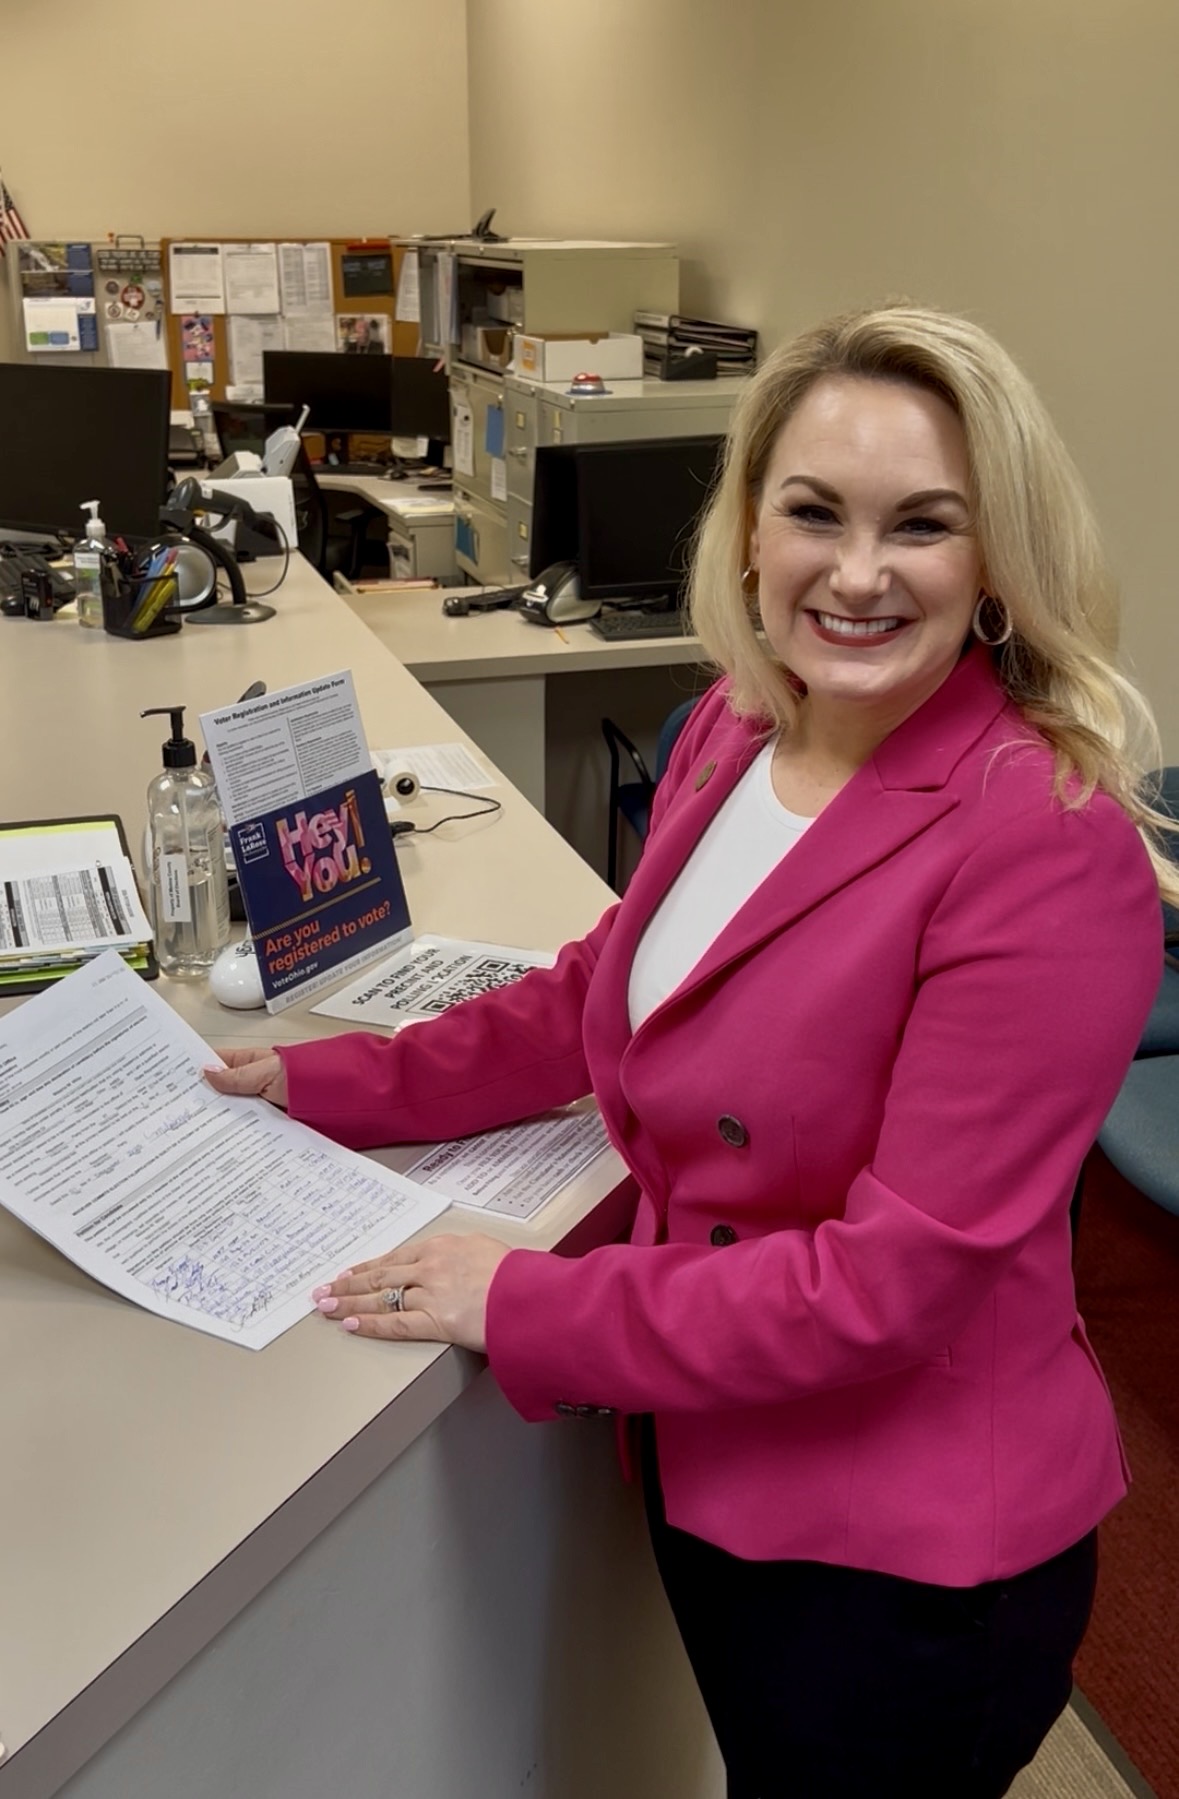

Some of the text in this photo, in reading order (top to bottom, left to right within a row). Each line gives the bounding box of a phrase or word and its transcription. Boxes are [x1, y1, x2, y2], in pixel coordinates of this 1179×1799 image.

[214, 715, 231, 725] Voter
[232, 704, 268, 719] Registration
[281, 690, 311, 704] Information
[312, 683, 330, 694] Update
[331, 679, 344, 687] Form
[240, 832, 262, 845] Frank
[241, 840, 266, 853] LaRose
[267, 934, 293, 956] Are
[293, 920, 321, 946] you
[268, 926, 340, 974] registered
[343, 923, 357, 936] to
[358, 901, 390, 928] vote?
[272, 962, 318, 989] VoteOhio.gov
[320, 968, 343, 985] UPDATE
[345, 959, 360, 971] YOUR
[352, 948, 439, 1006] SCAN TO FIND YOUR
[385, 959, 444, 1000] PRECINT AND
[391, 984, 432, 1010] POLLING
[422, 1152, 453, 1172] Ready
[447, 1144, 461, 1152] to
